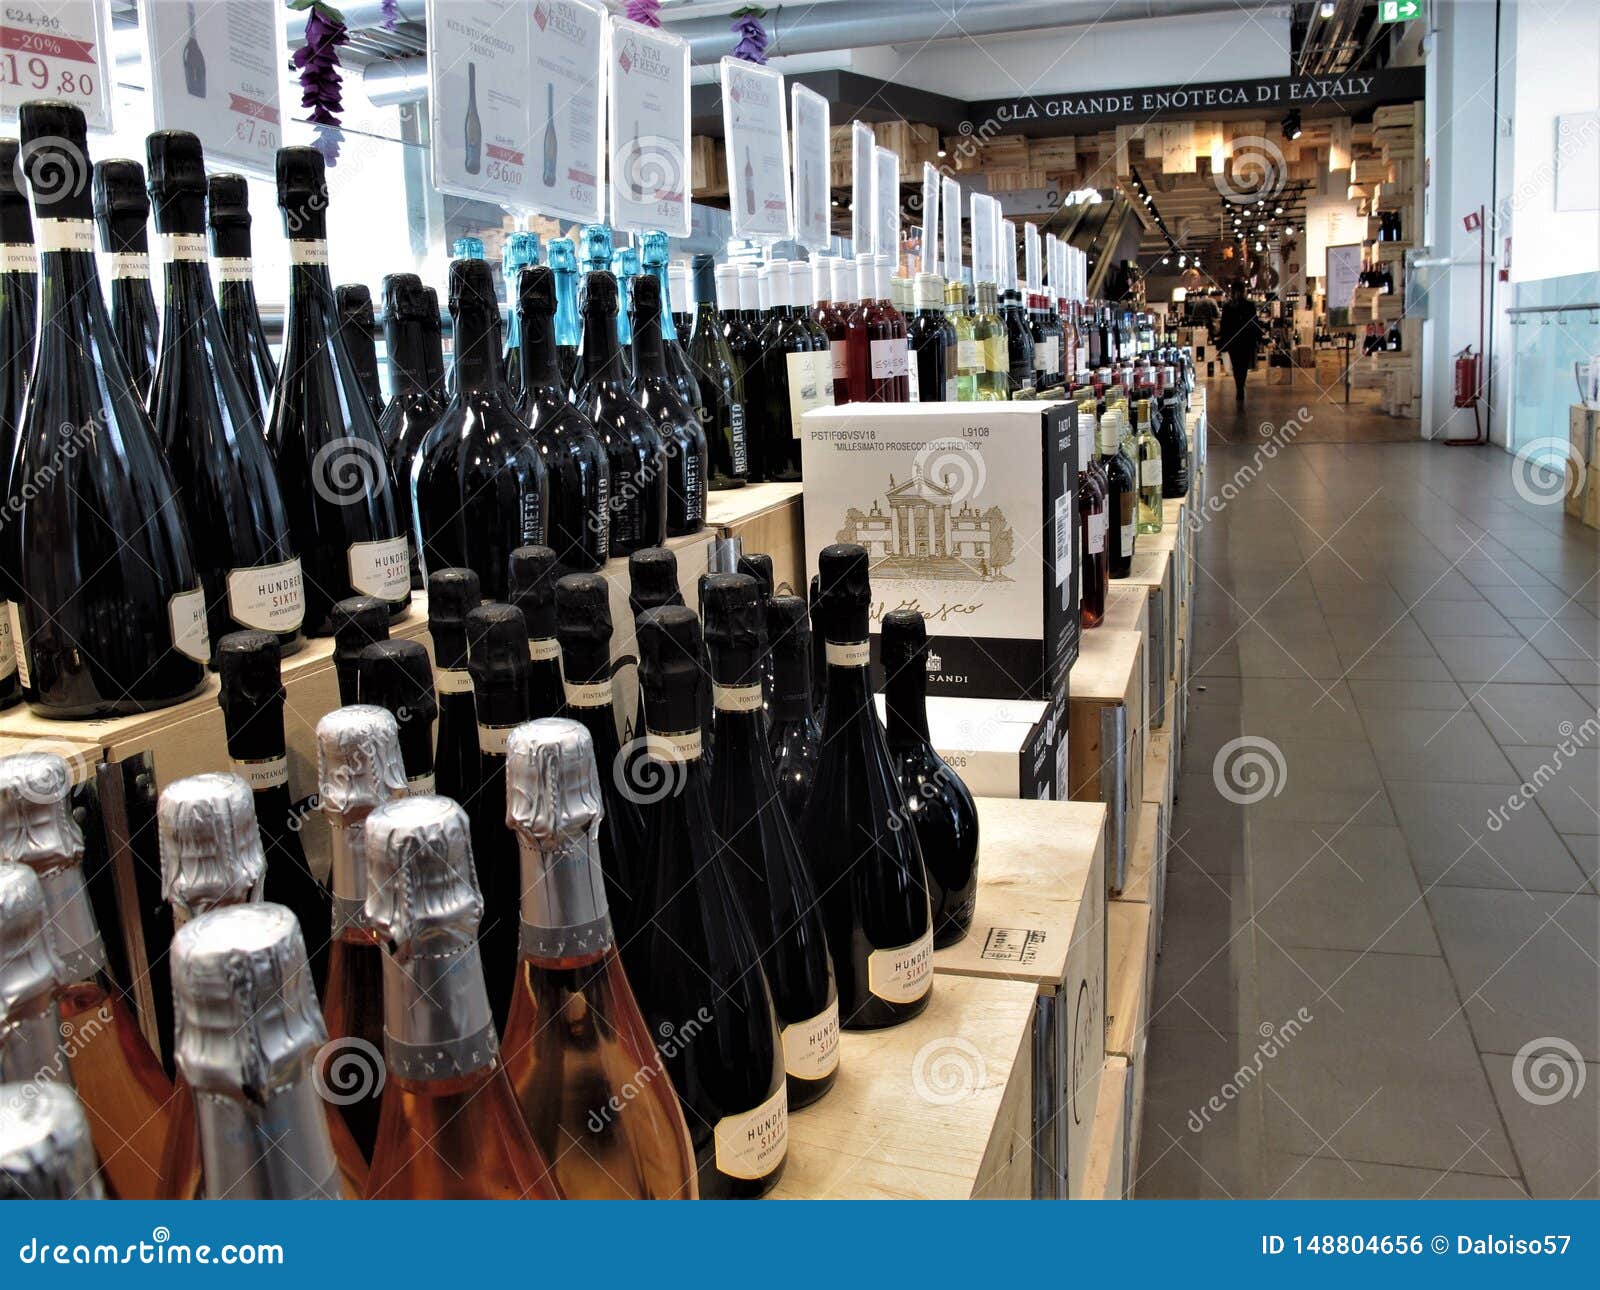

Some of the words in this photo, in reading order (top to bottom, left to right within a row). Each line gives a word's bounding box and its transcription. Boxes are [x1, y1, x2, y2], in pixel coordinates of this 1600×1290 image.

[12, 35, 61, 54] -20%
[642, 46, 661, 60] STAI
[1012, 103, 1038, 119] LA
[1046, 96, 1134, 117] GRANDE
[1142, 88, 1249, 110] ENOTECA
[1256, 84, 1281, 102] DI
[1289, 77, 1375, 99] EATALY
[236, 119, 276, 149] €7,50
[732, 403, 745, 474] BUSCARETO
[962, 427, 990, 438] L9108
[886, 442, 927, 451] PROSECCO
[272, 591, 298, 608] SIXTY
[928, 674, 969, 683] SANDI
